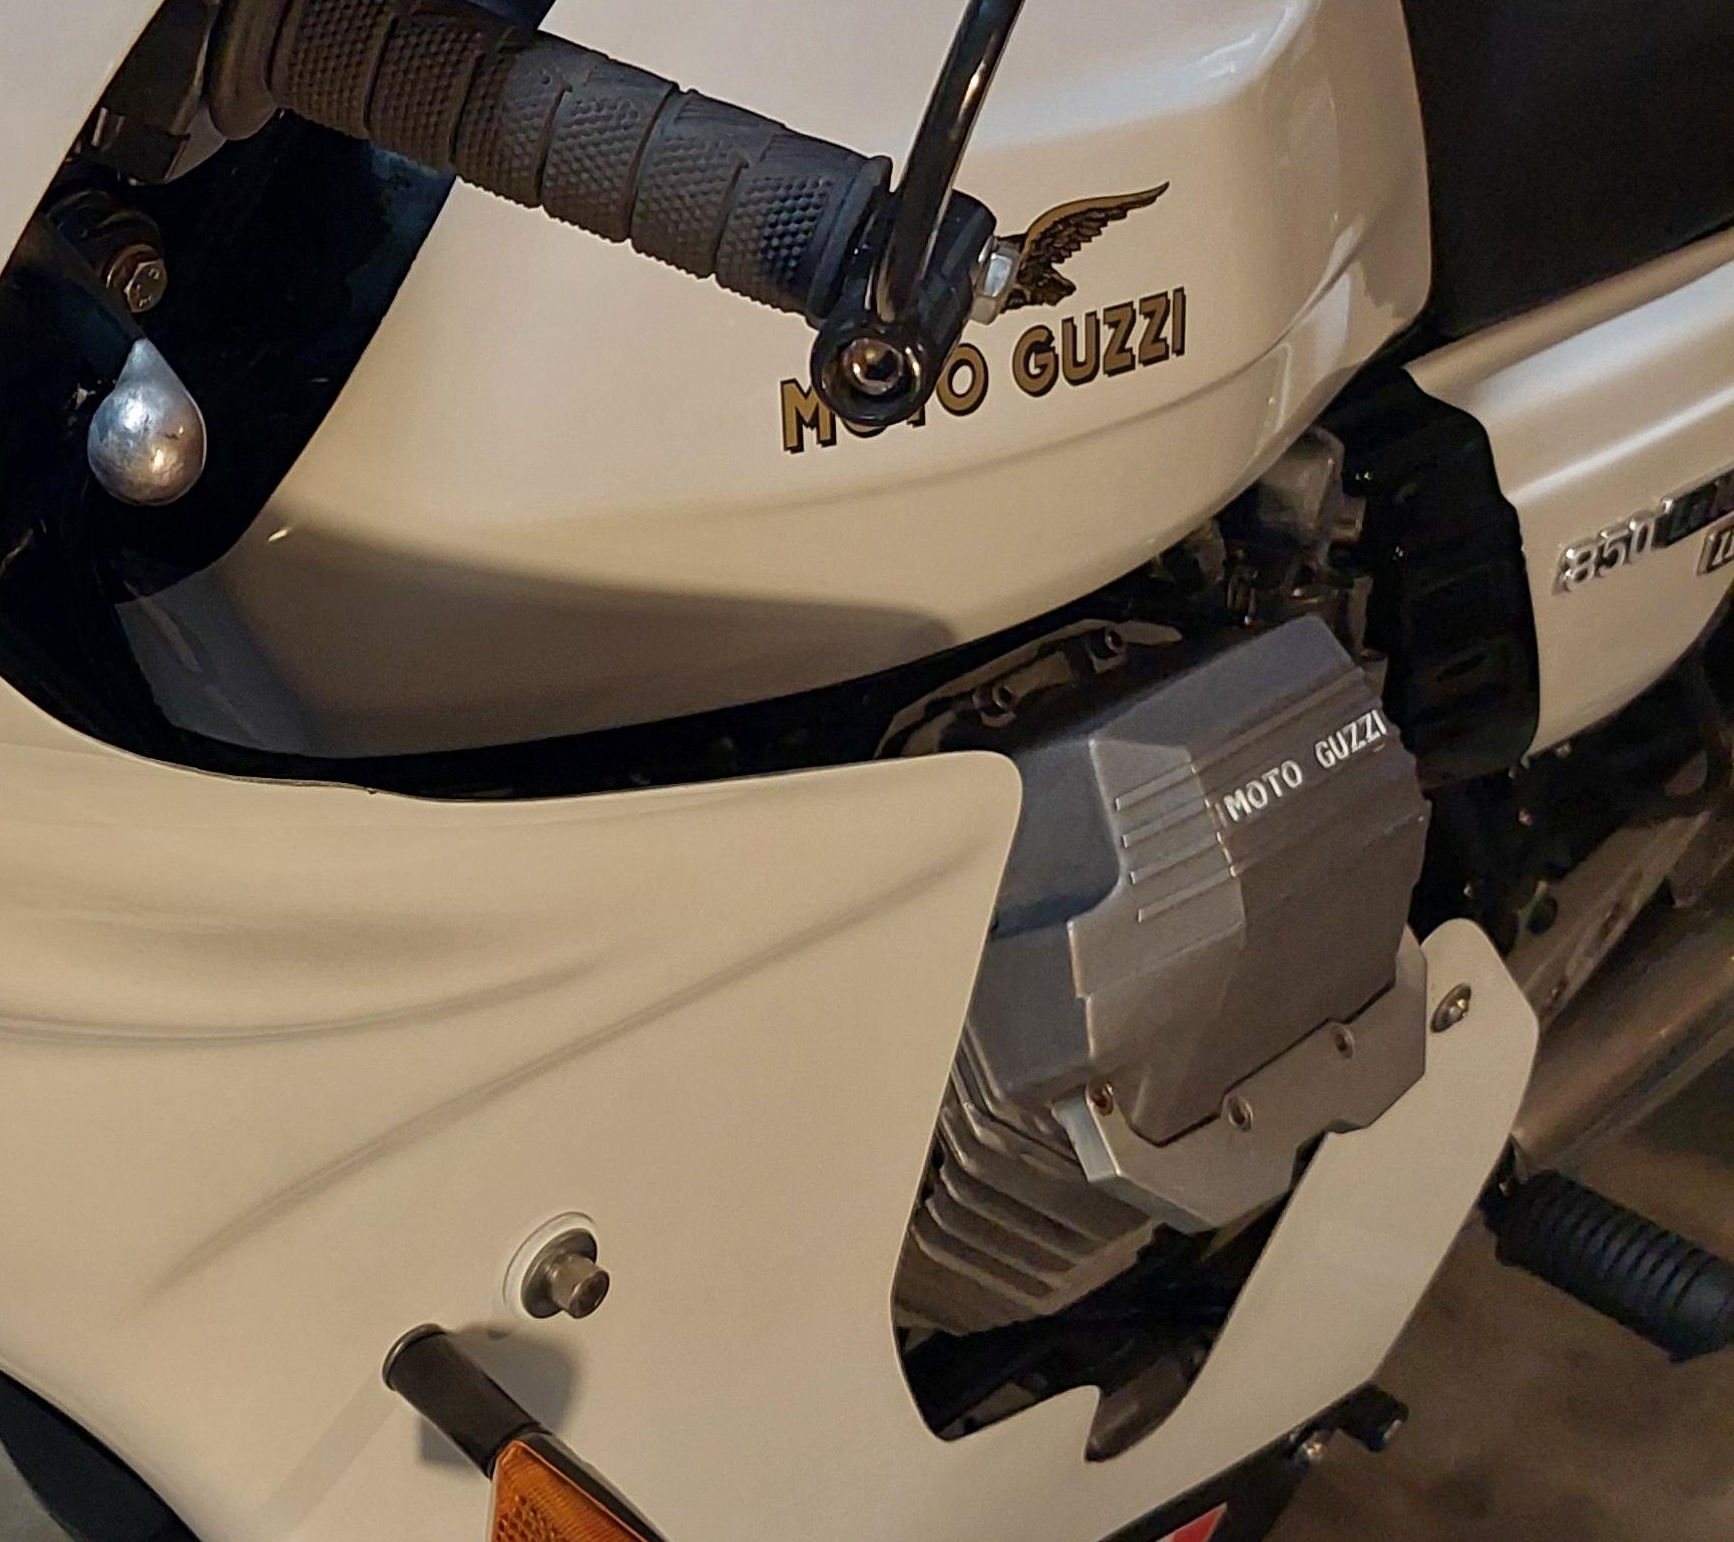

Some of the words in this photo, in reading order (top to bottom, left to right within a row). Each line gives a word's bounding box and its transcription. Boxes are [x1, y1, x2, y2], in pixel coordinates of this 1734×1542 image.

[779, 343, 989, 454] MO
[1012, 286, 1186, 398] GUZZI
[1552, 509, 1657, 596] 850
[1223, 759, 1303, 822] MOTO
[1314, 708, 1388, 770] GUZZI
